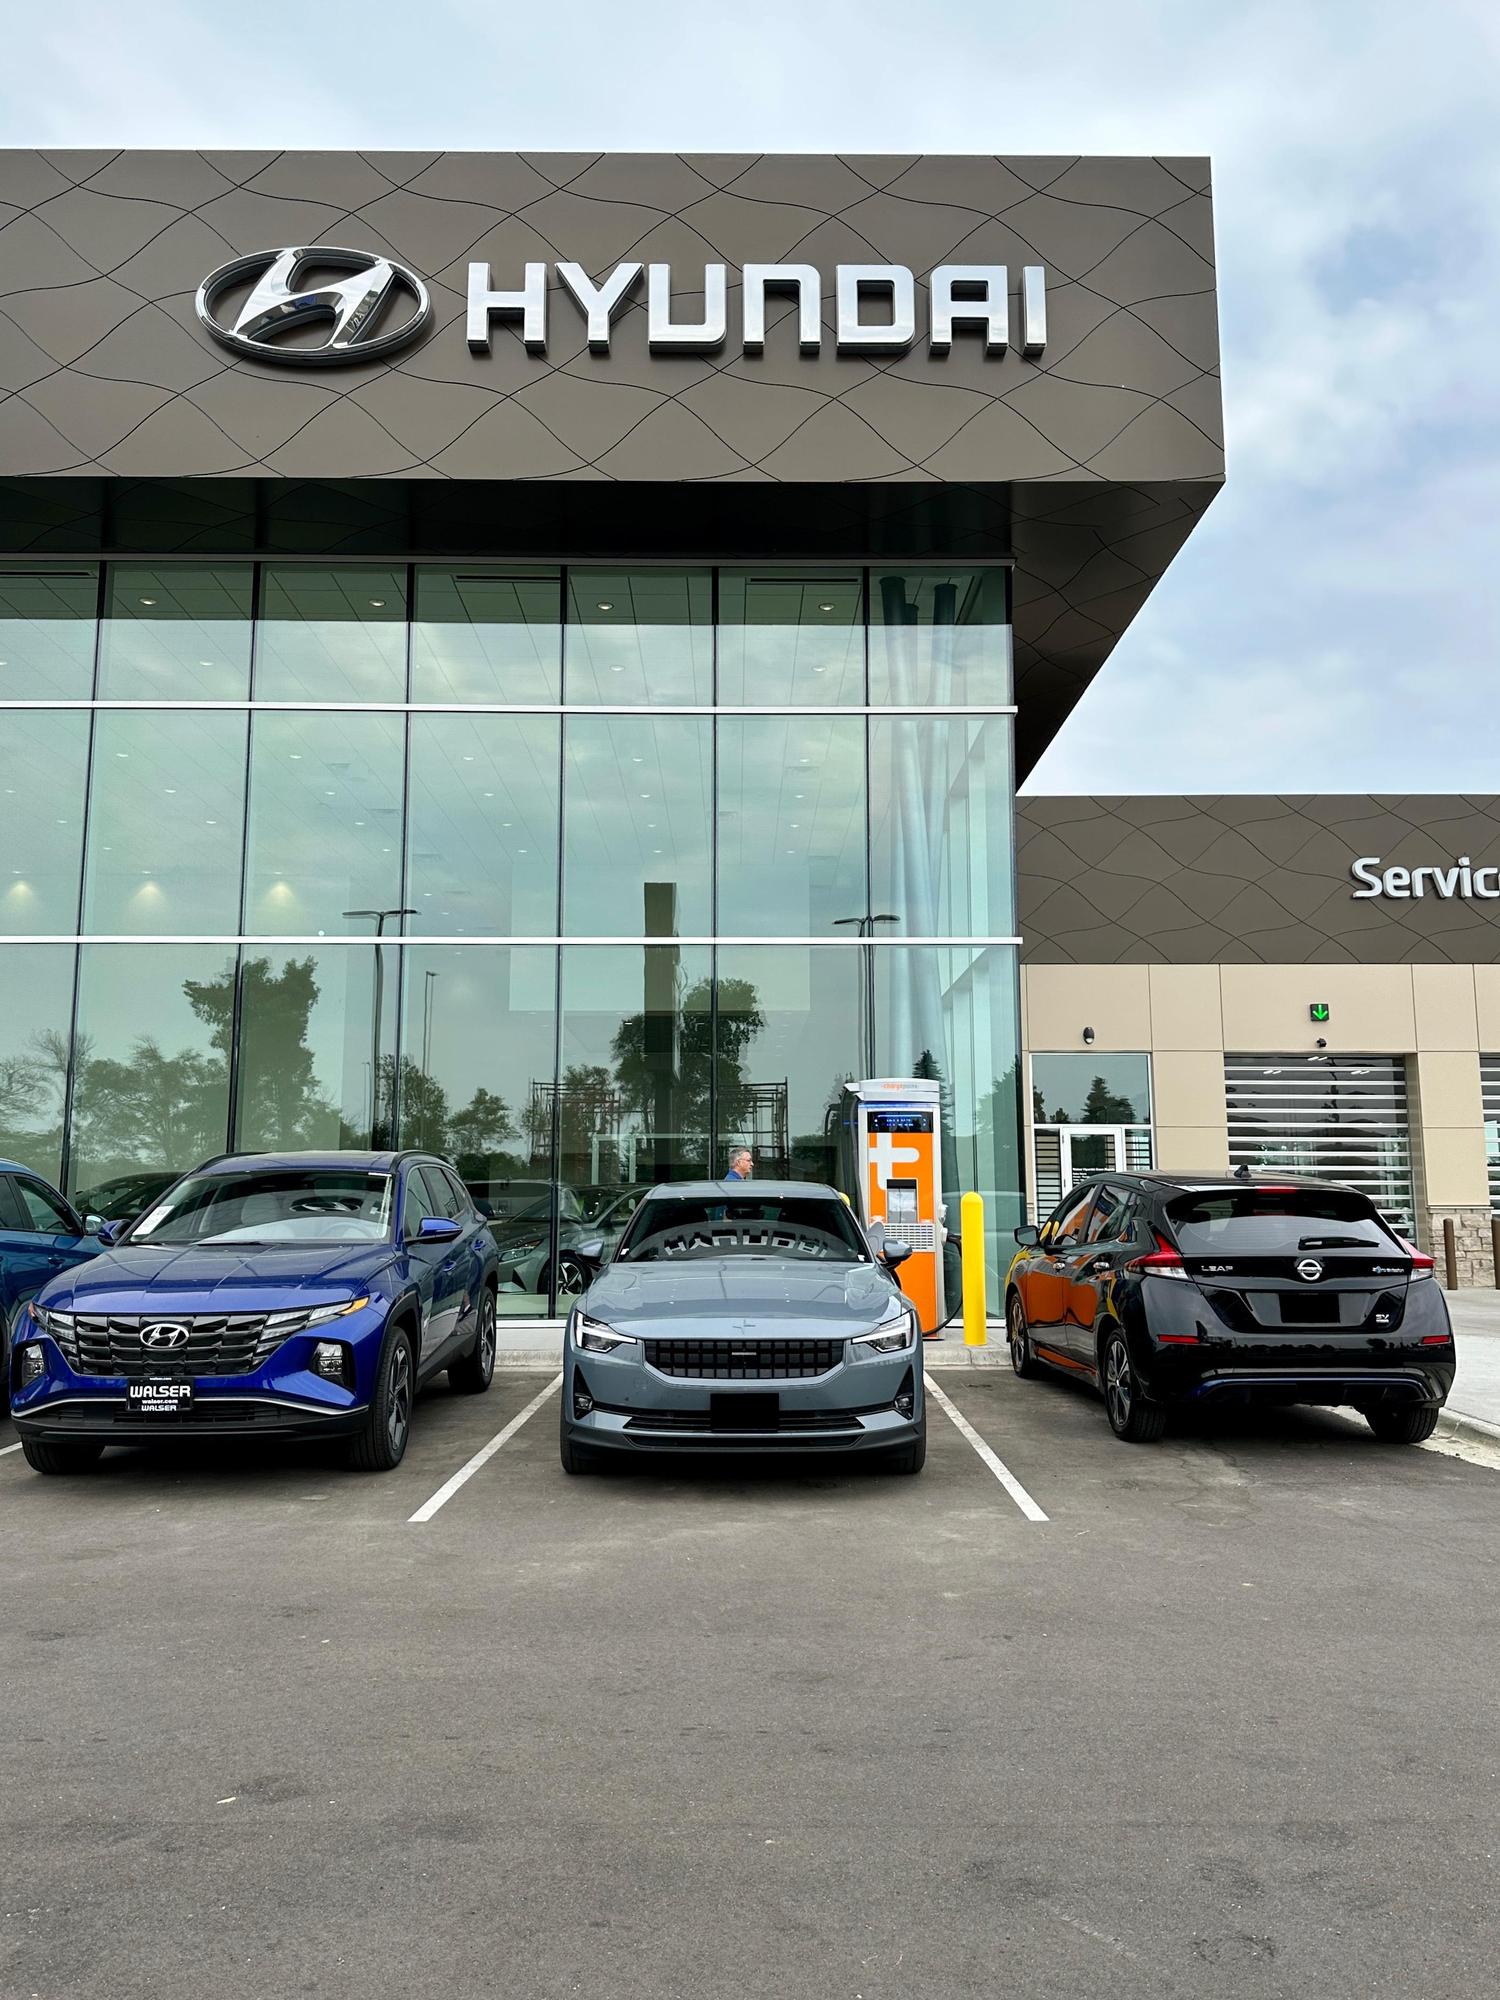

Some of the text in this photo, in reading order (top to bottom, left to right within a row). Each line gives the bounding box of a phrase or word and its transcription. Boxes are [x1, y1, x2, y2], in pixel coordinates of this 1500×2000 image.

[466, 261, 1047, 356] HYUNDAI
[1351, 856, 1500, 899] Servic
[129, 1385, 191, 1398] WALSER
